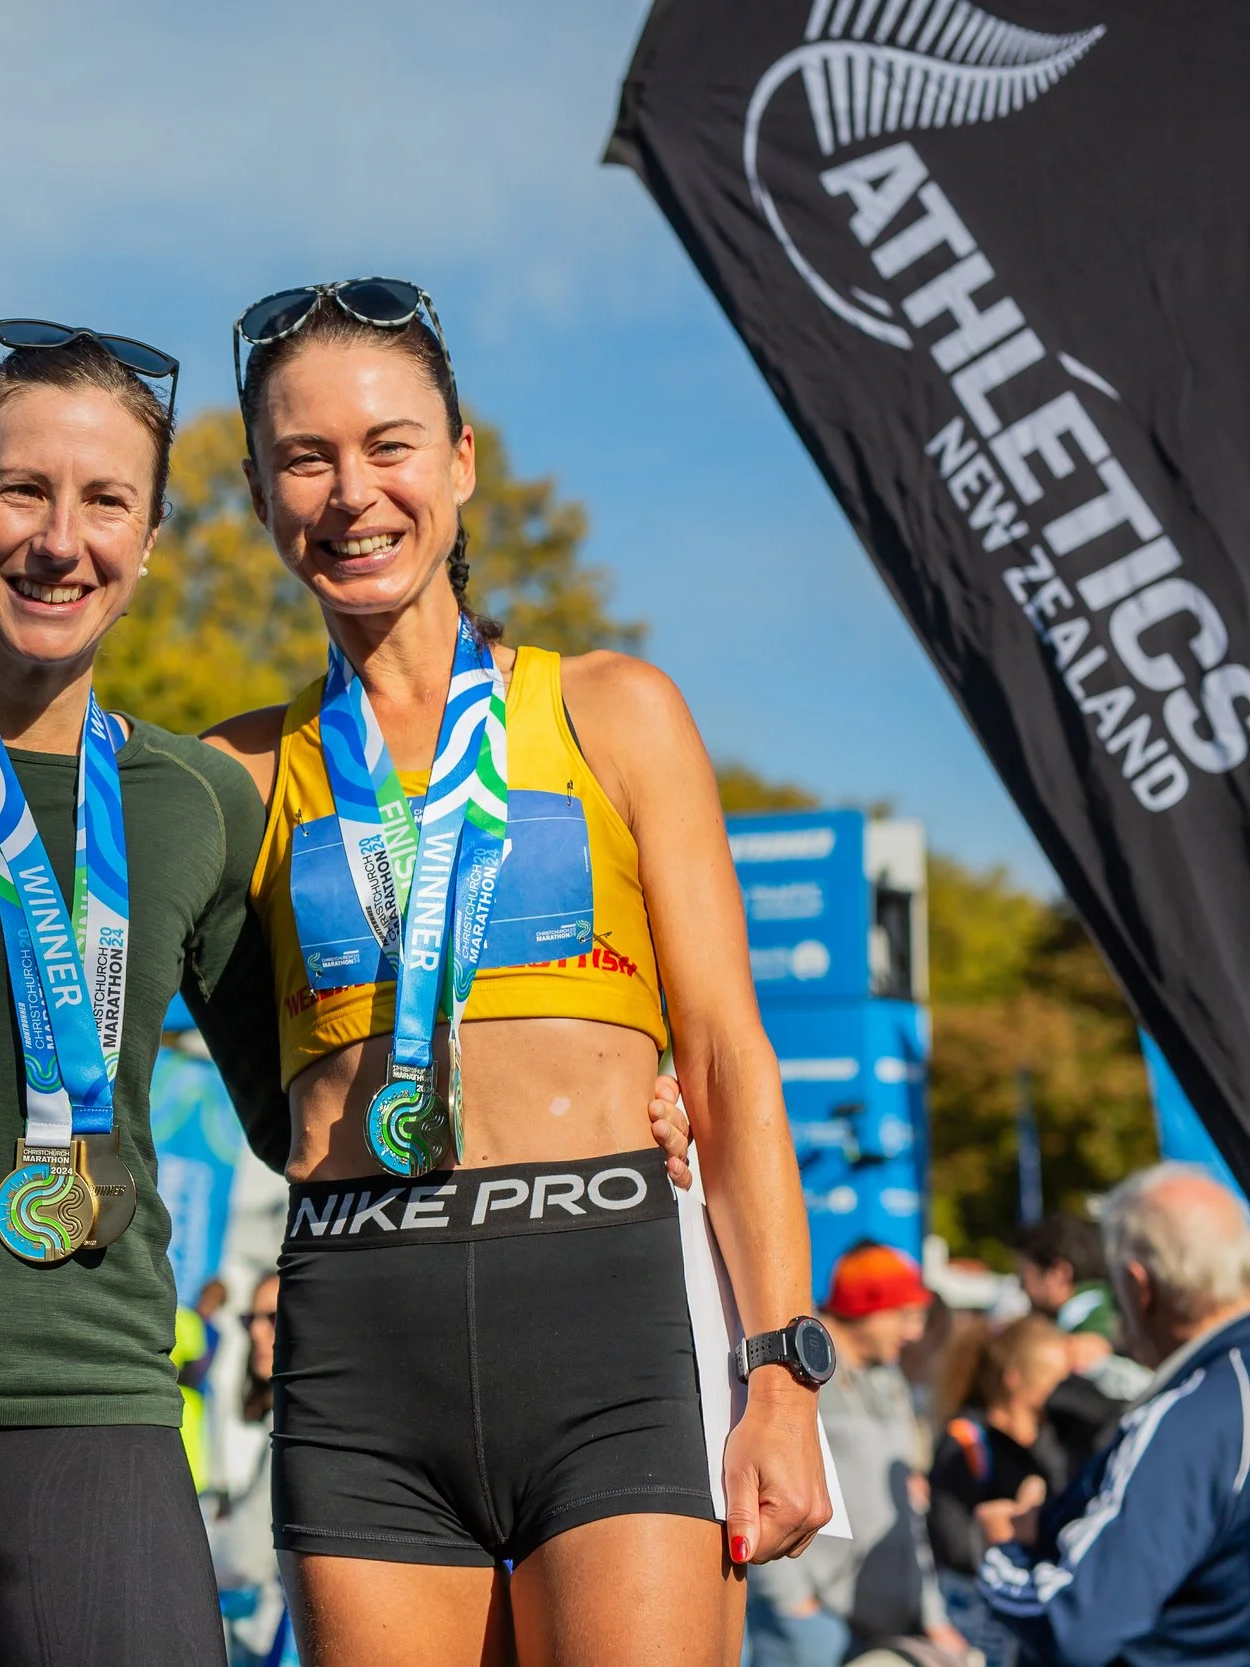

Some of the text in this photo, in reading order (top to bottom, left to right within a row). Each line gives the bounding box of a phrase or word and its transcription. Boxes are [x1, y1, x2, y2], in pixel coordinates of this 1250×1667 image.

[819, 142, 1250, 773] ATHLETICS
[925, 416, 1190, 812] NEW ZEALAND
[358, 838, 397, 942] CHRISTCHURCH 20
[373, 834, 385, 851] 24
[19, 865, 83, 1010] WINNER
[410, 832, 454, 972] WINNER
[462, 848, 487, 959] CHRISTCHURCH 20
[469, 863, 498, 964] MARATHON
[21, 949, 45, 1050] CHRISTCHURCH
[93, 927, 112, 1037] RISTCHURCH 20
[103, 929, 124, 1048] MARATHON 24
[22, 1155, 70, 1164] MARATHON
[23, 1149, 70, 1157] CHRISTCHURCH
[51, 1166, 73, 1175] 2024
[290, 1167, 647, 1237] NIKE PRO
